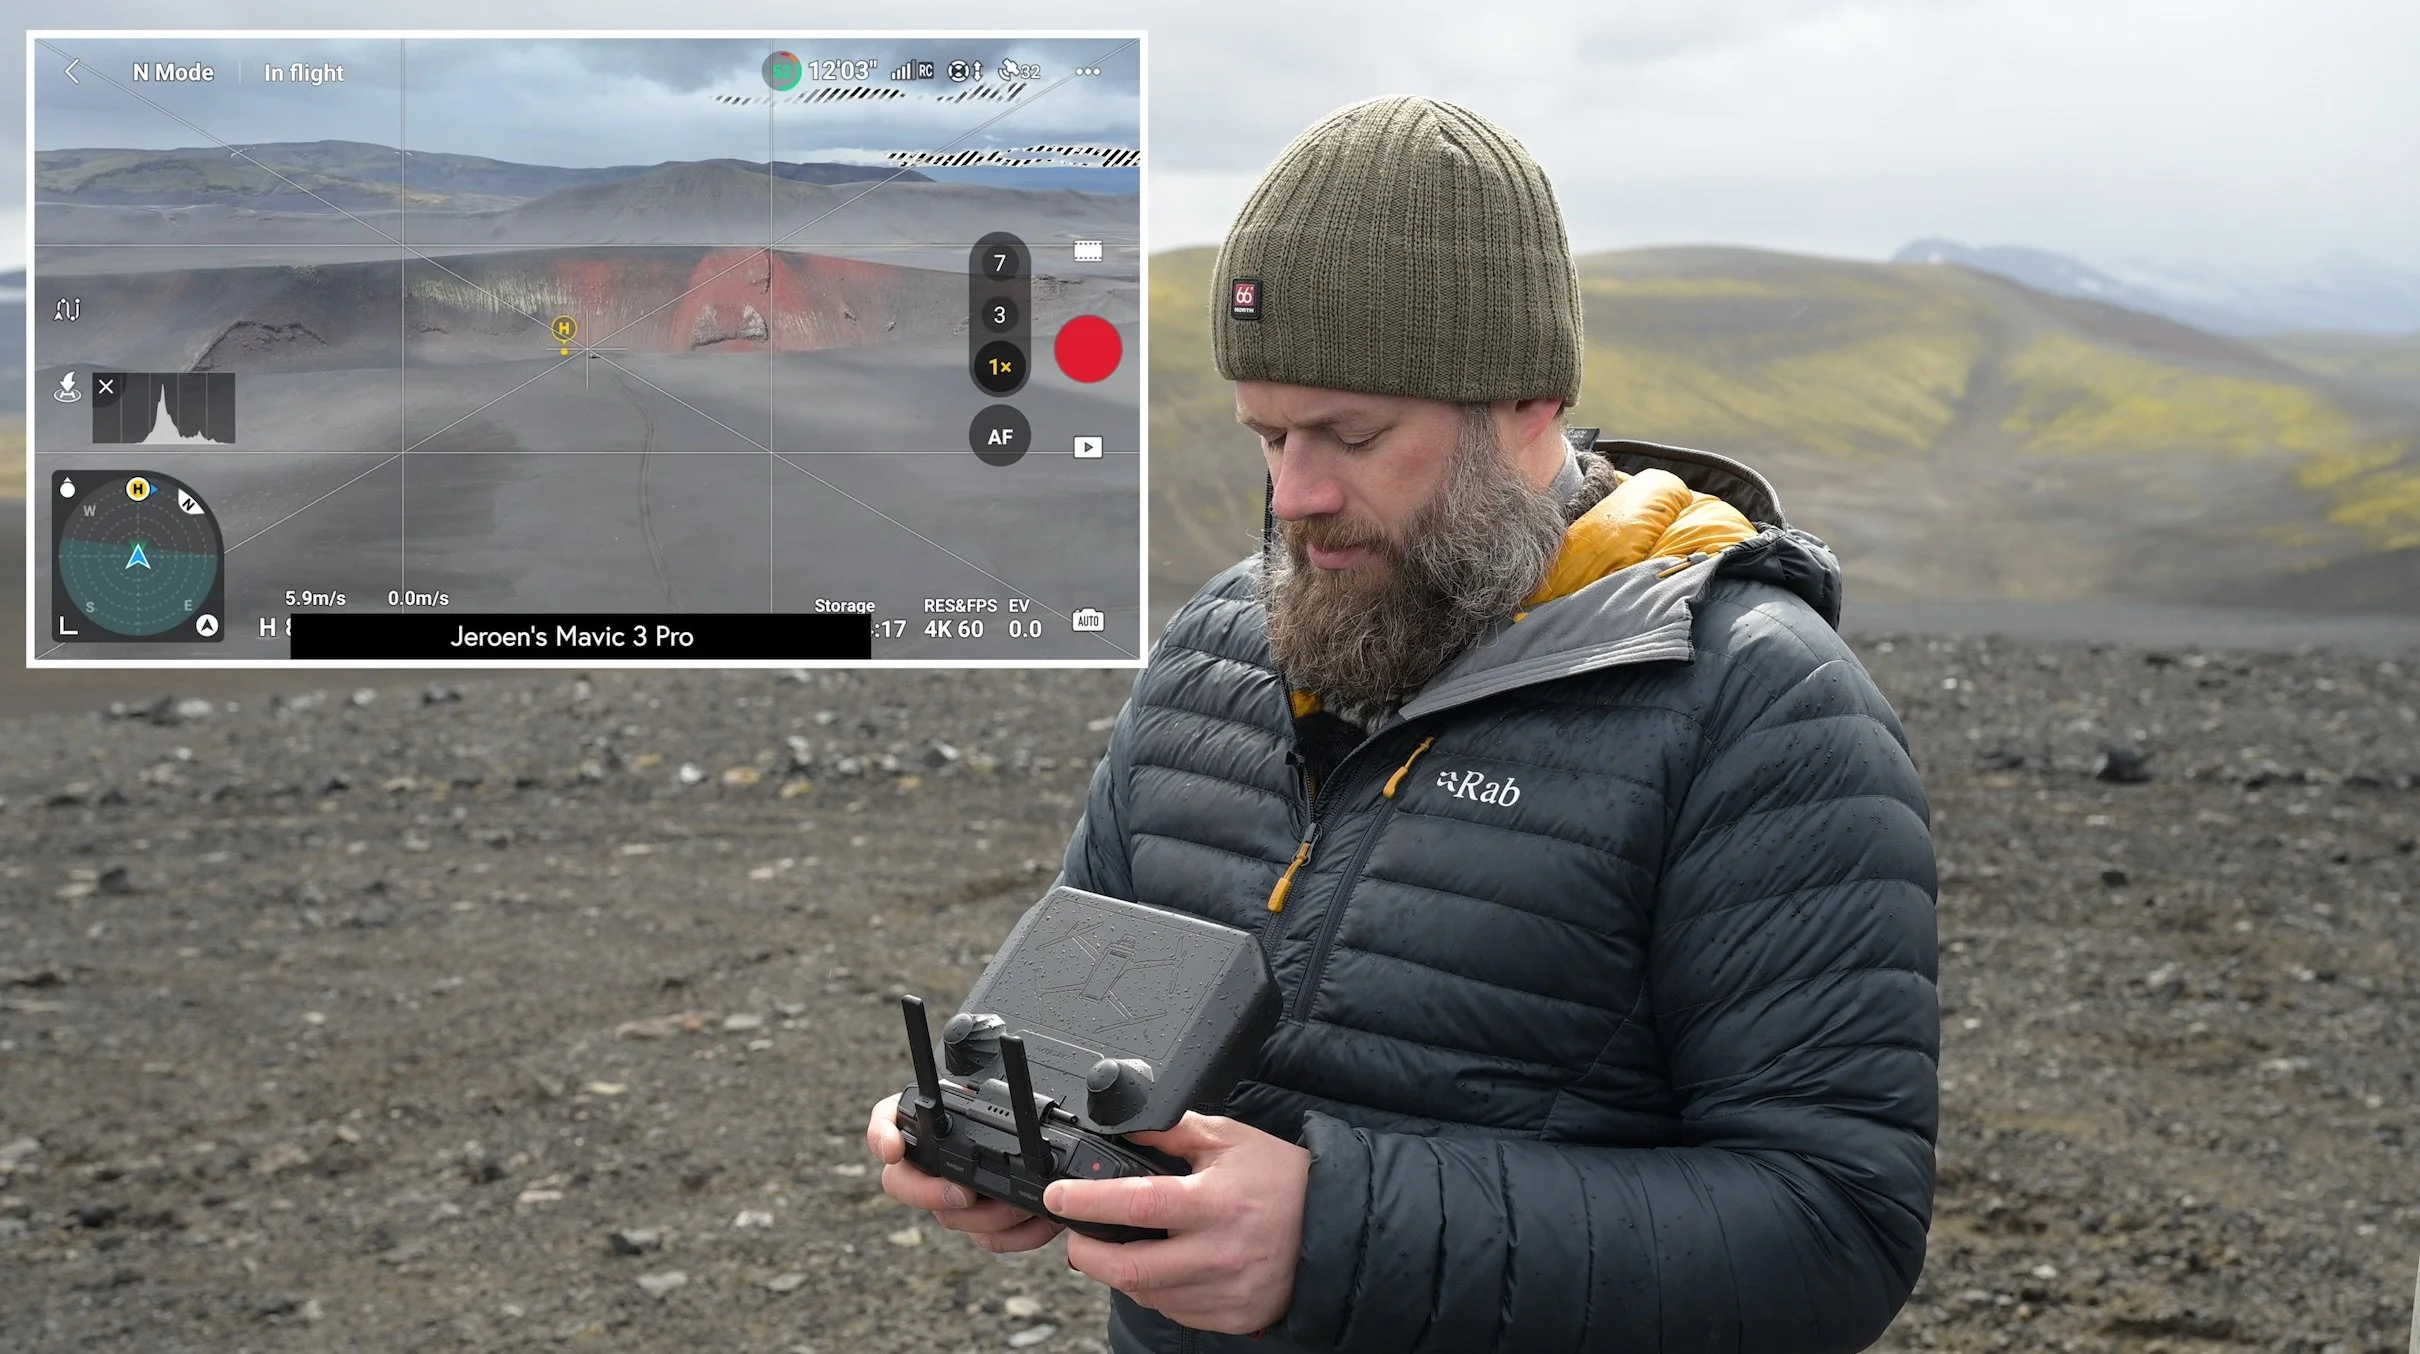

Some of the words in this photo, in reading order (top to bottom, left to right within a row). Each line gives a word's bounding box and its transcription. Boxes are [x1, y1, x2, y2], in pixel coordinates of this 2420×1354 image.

[133, 63, 149, 82] N
[155, 63, 215, 82] Mode
[264, 63, 282, 82] In
[290, 63, 344, 86] flight
[808, 60, 879, 81] 12'03"
[919, 63, 933, 78] RC
[1020, 64, 1041, 80] 32
[993, 254, 1007, 272] 7
[993, 305, 1006, 324] 3
[558, 321, 570, 335] H
[987, 428, 1013, 445] AF
[133, 483, 143, 495] H
[84, 505, 97, 517] W
[182, 498, 195, 511] N
[86, 601, 95, 613] S
[184, 599, 193, 611] E
[284, 590, 347, 607] 5.9m/s
[388, 590, 449, 607] 0.0m/s
[814, 598, 876, 614] Storage
[924, 598, 998, 614] RES&FPS
[1009, 598, 1030, 614] EV
[259, 617, 276, 637] H
[870, 619, 907, 638] :17
[924, 619, 953, 638] 4K
[957, 619, 985, 638] 60
[1008, 619, 1042, 638] 0.0
[1078, 615, 1099, 628] AUTO
[1453, 770, 1521, 807] Rab
